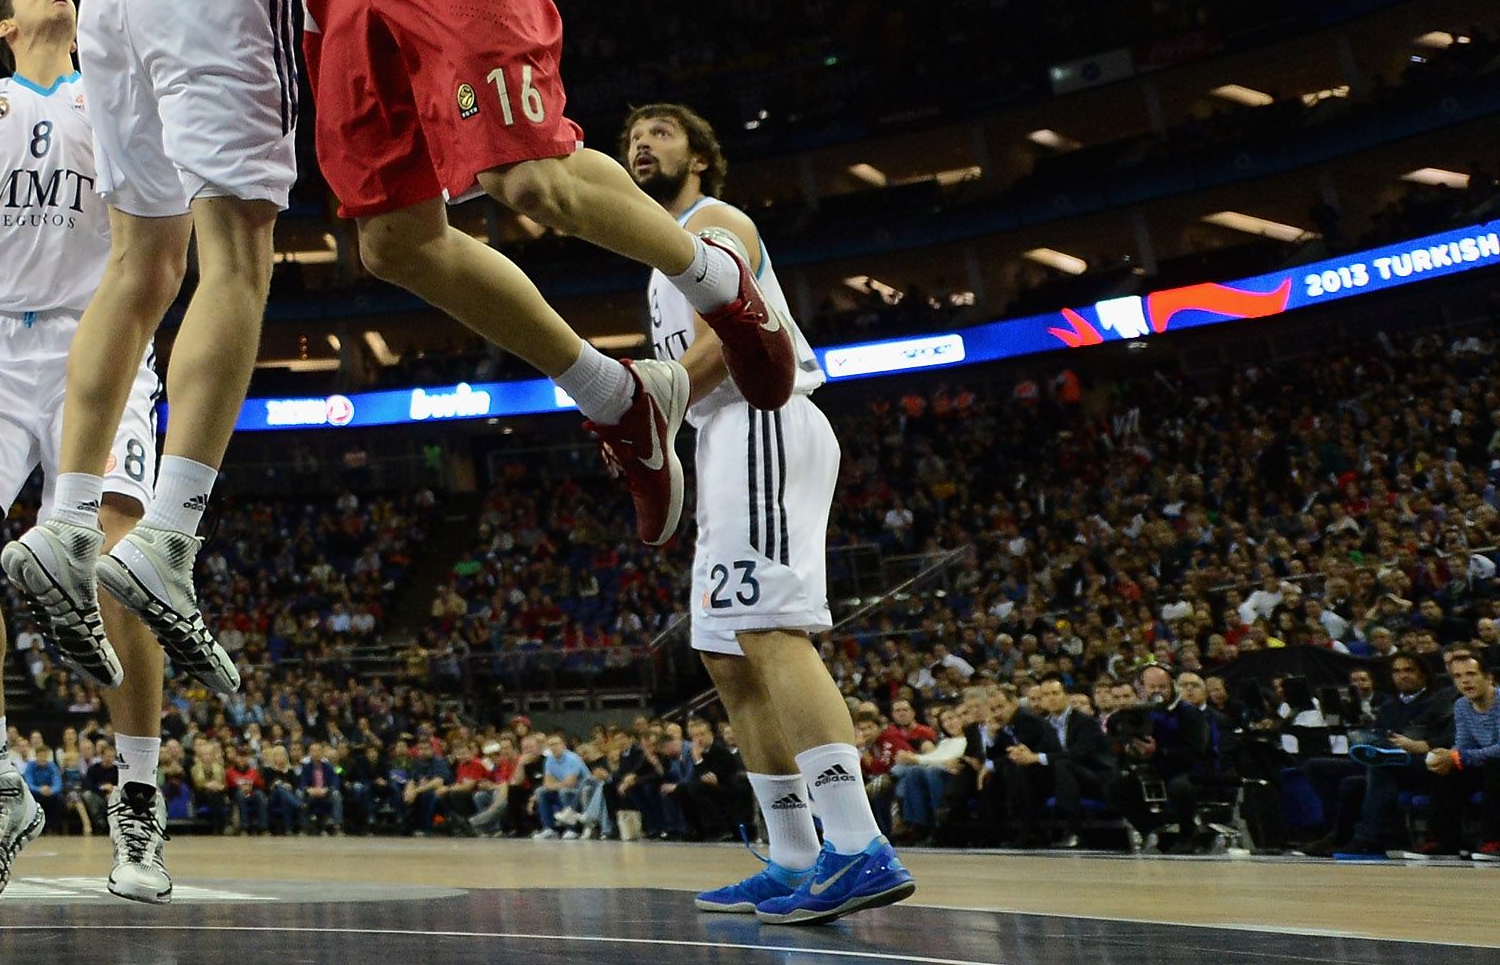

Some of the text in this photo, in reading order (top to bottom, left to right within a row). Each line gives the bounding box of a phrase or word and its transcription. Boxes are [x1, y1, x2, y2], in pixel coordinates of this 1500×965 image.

[486, 63, 546, 126] 16
[29, 120, 54, 159] 8
[1305, 232, 1500, 297] 2013 TURKISH
[124, 438, 146, 482] 8
[710, 560, 760, 609] 23
[815, 775, 856, 787] adidas
